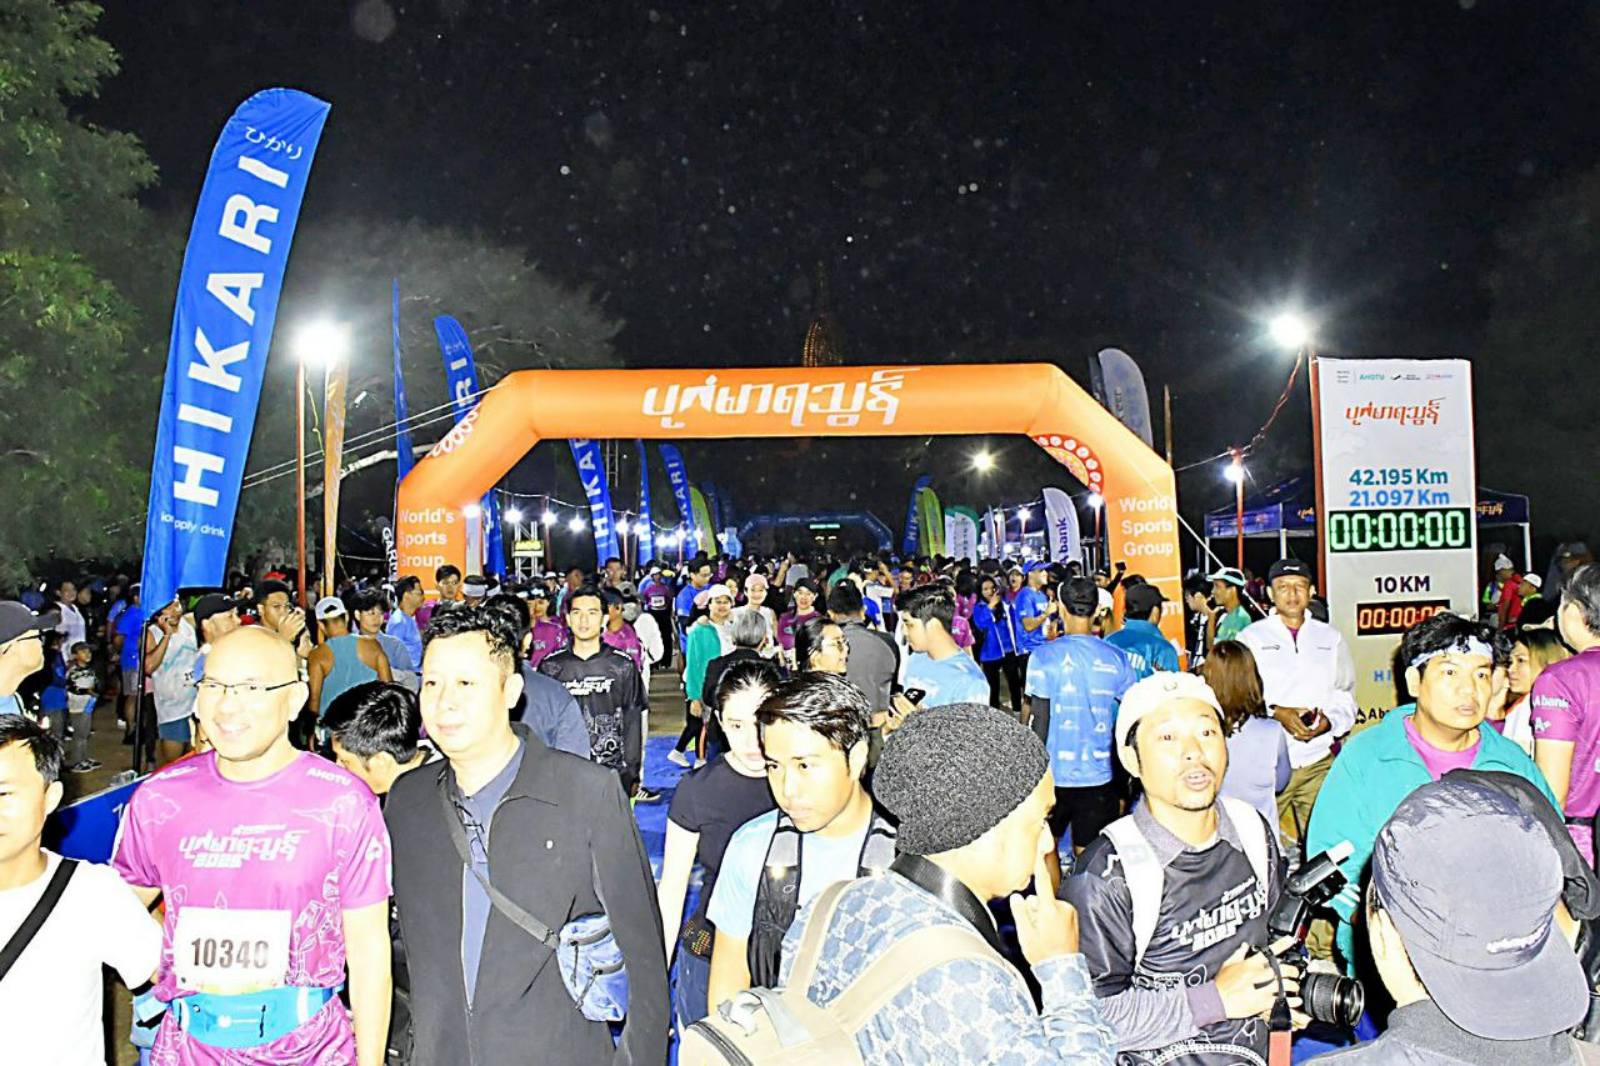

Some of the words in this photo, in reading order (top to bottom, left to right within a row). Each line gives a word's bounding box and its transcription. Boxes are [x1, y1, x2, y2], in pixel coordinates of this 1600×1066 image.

[245, 126, 302, 159] ひかり
[173, 155, 289, 507] HIKARI
[574, 440, 609, 539] HIKA
[1349, 469, 1412, 486] 42.195
[1416, 468, 1448, 485] Km
[1349, 490, 1414, 507] 21.097
[1418, 489, 1450, 506] Km
[1330, 510, 1466, 551] 00:00:00
[1374, 576, 1397, 594] 10
[1400, 575, 1430, 593] KM
[1360, 606, 1447, 629] 00:00:0
